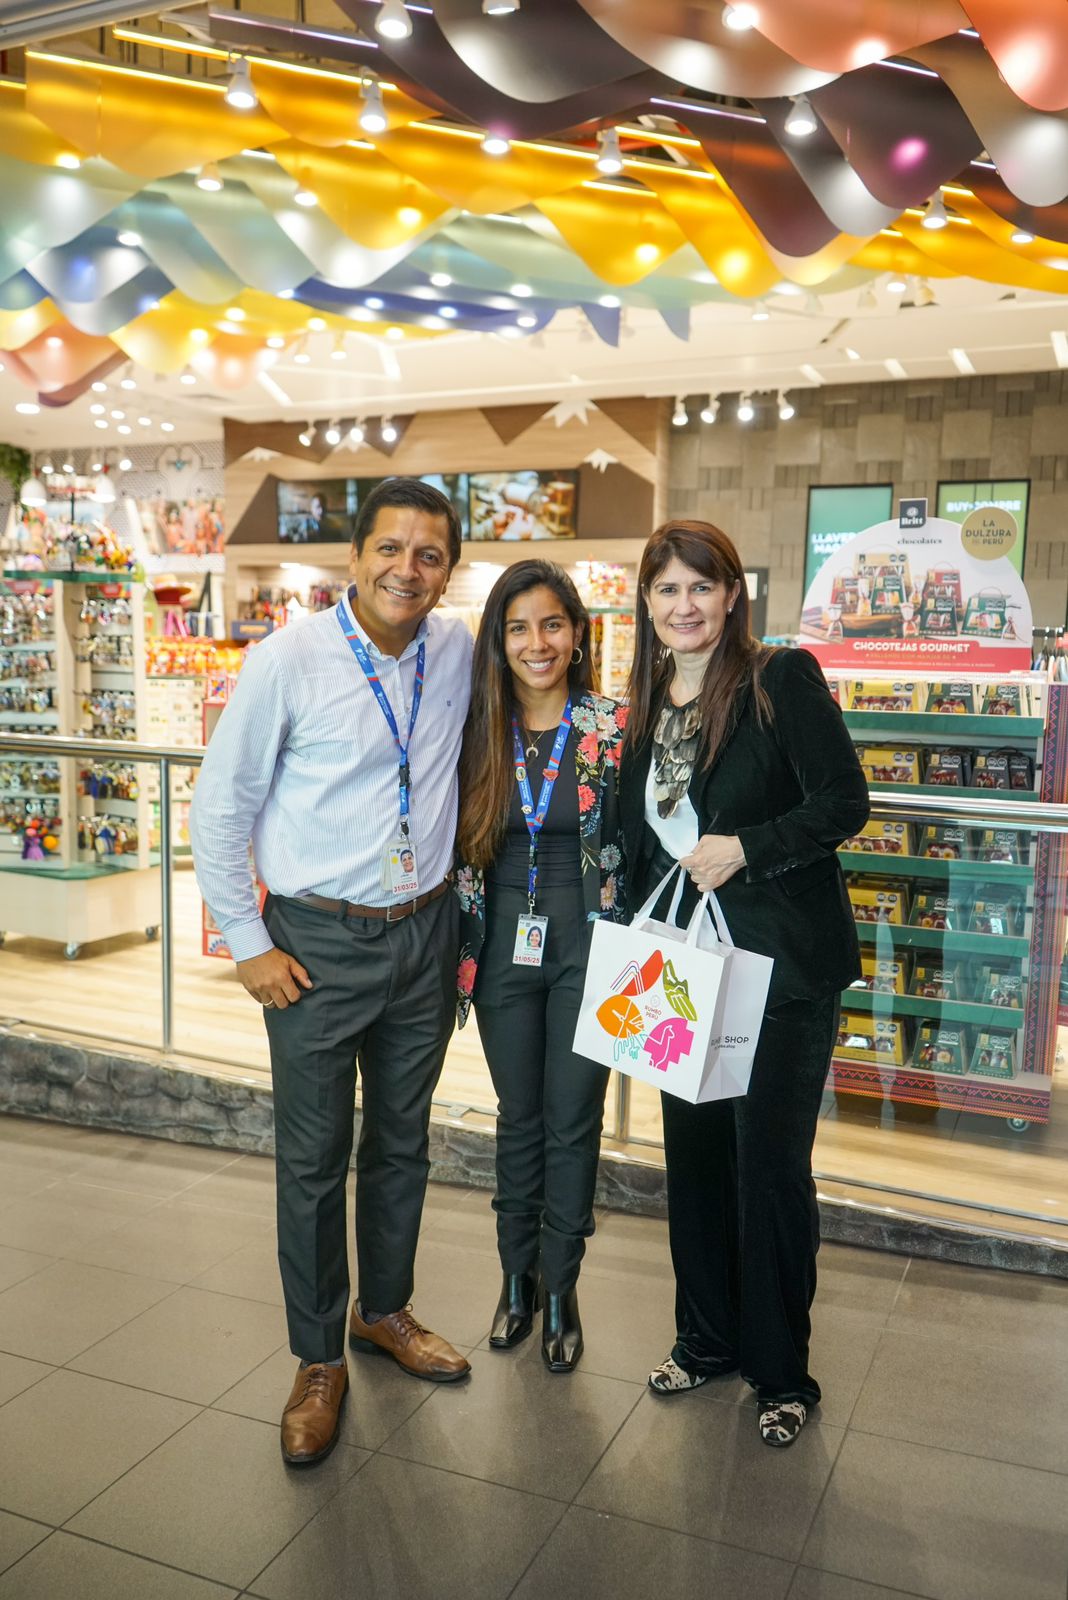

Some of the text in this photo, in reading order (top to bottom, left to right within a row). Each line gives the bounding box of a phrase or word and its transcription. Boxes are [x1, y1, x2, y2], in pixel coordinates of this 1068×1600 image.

[901, 517, 923, 525] Britt
[966, 529, 1012, 537] DULZURA
[898, 537, 942, 545] chocolates
[853, 641, 970, 653] CHOCOTEJAS GOURMET
[393, 882, 417, 893] 31/03/25
[514, 956, 540, 964] 31/05/25
[724, 1035, 750, 1044] SHOP
